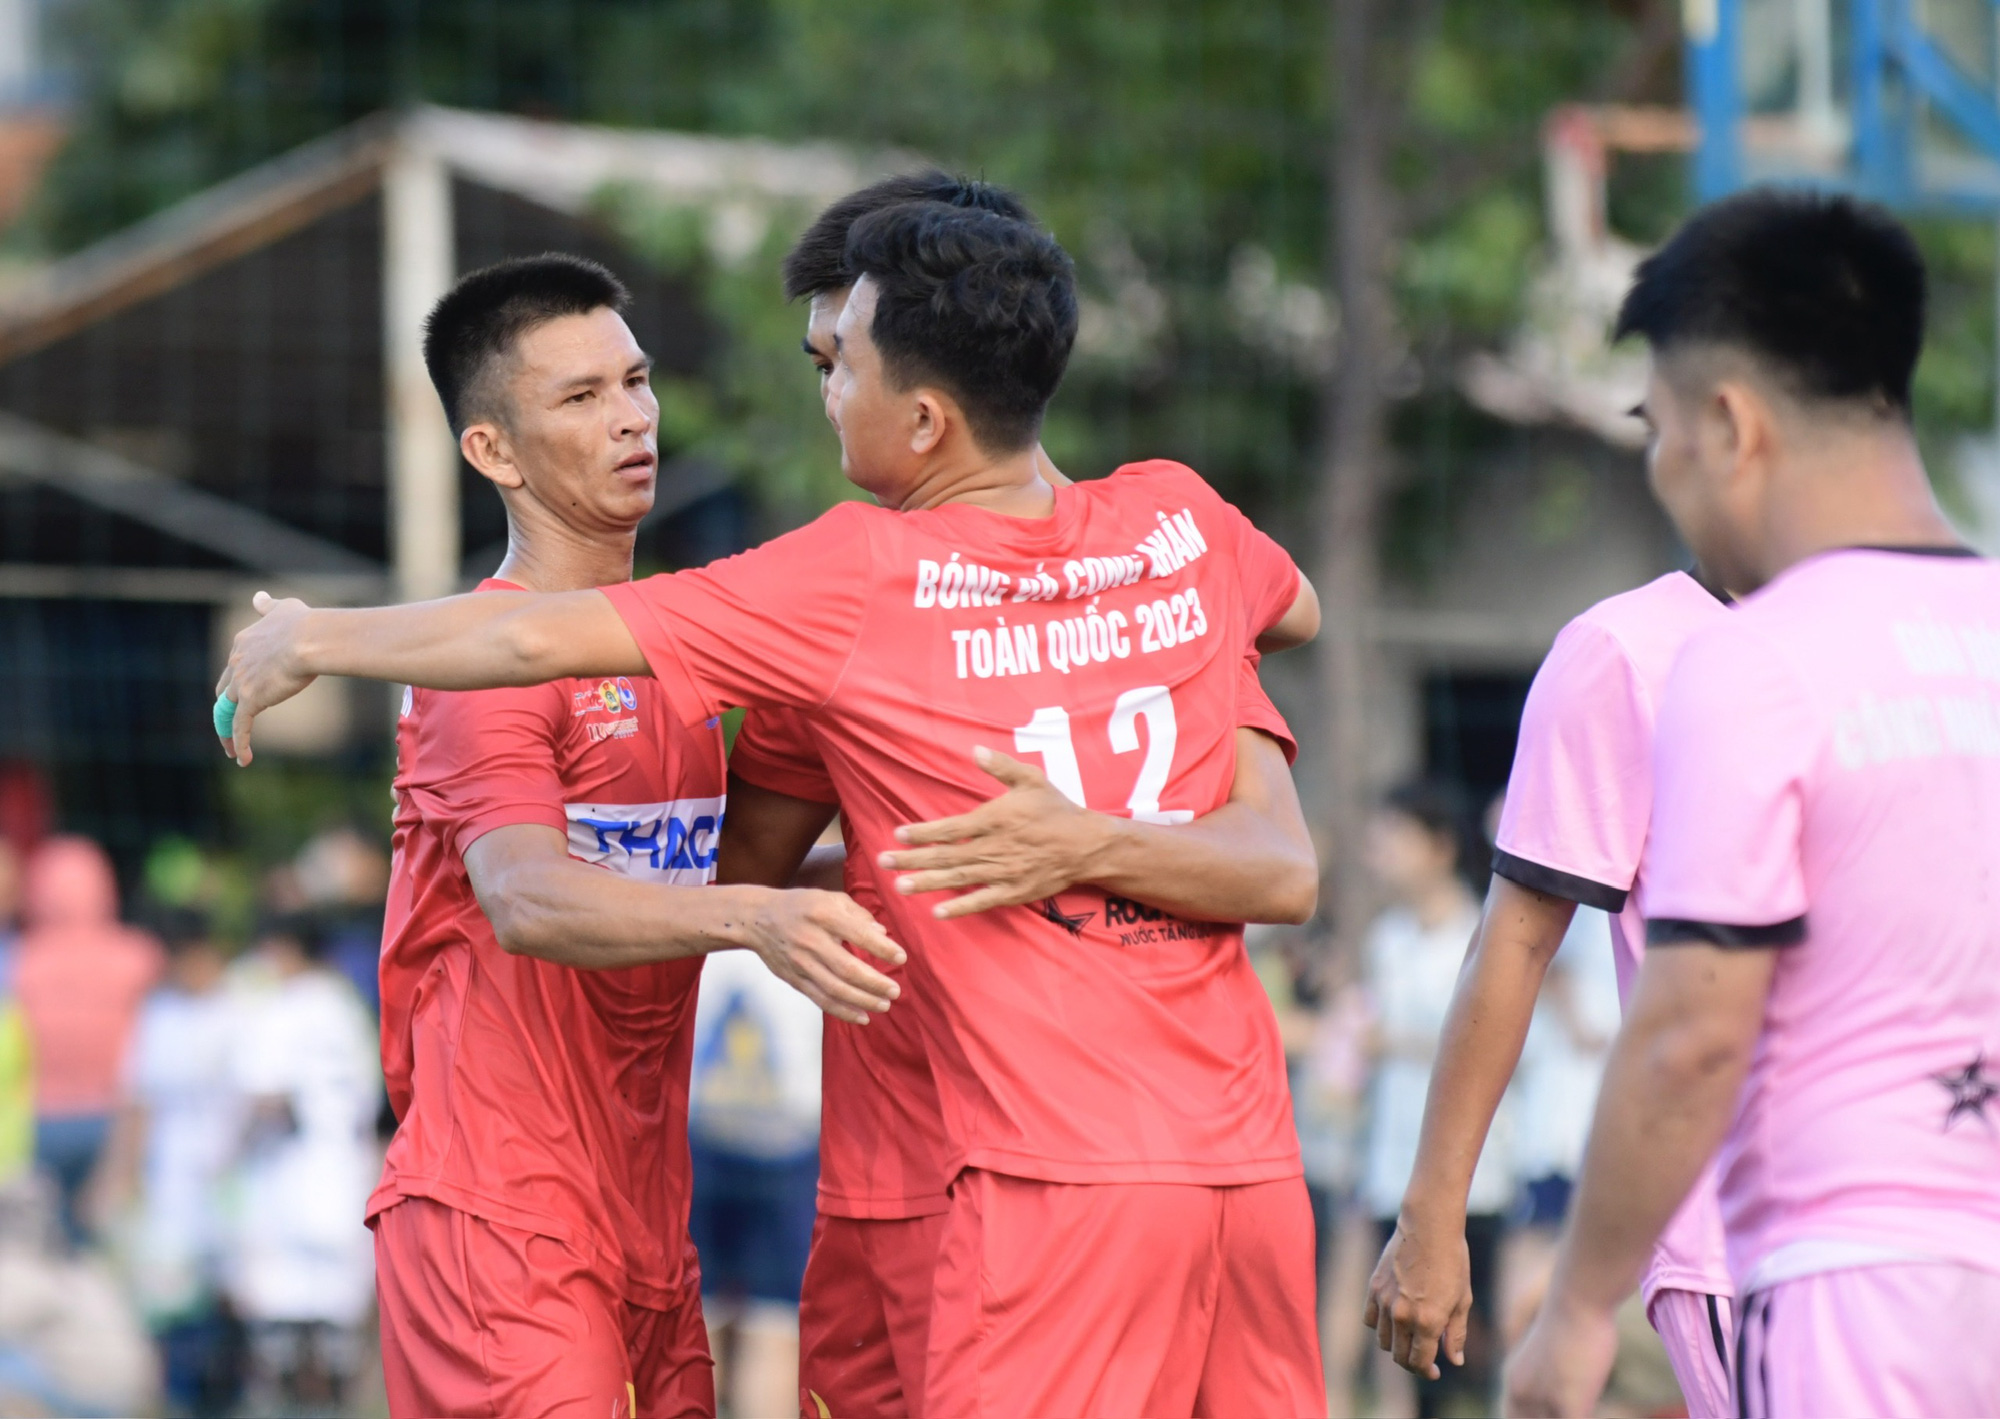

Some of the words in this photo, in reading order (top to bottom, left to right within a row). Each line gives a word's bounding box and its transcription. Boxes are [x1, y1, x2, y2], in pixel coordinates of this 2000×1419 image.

[914, 552, 1011, 609] BÓNG
[951, 616, 1041, 679] TOÀN
[1046, 596, 1132, 674] QUỐC
[1134, 587, 1208, 653] 2023
[1014, 685, 1195, 826] 12
[577, 813, 725, 869] THAC
